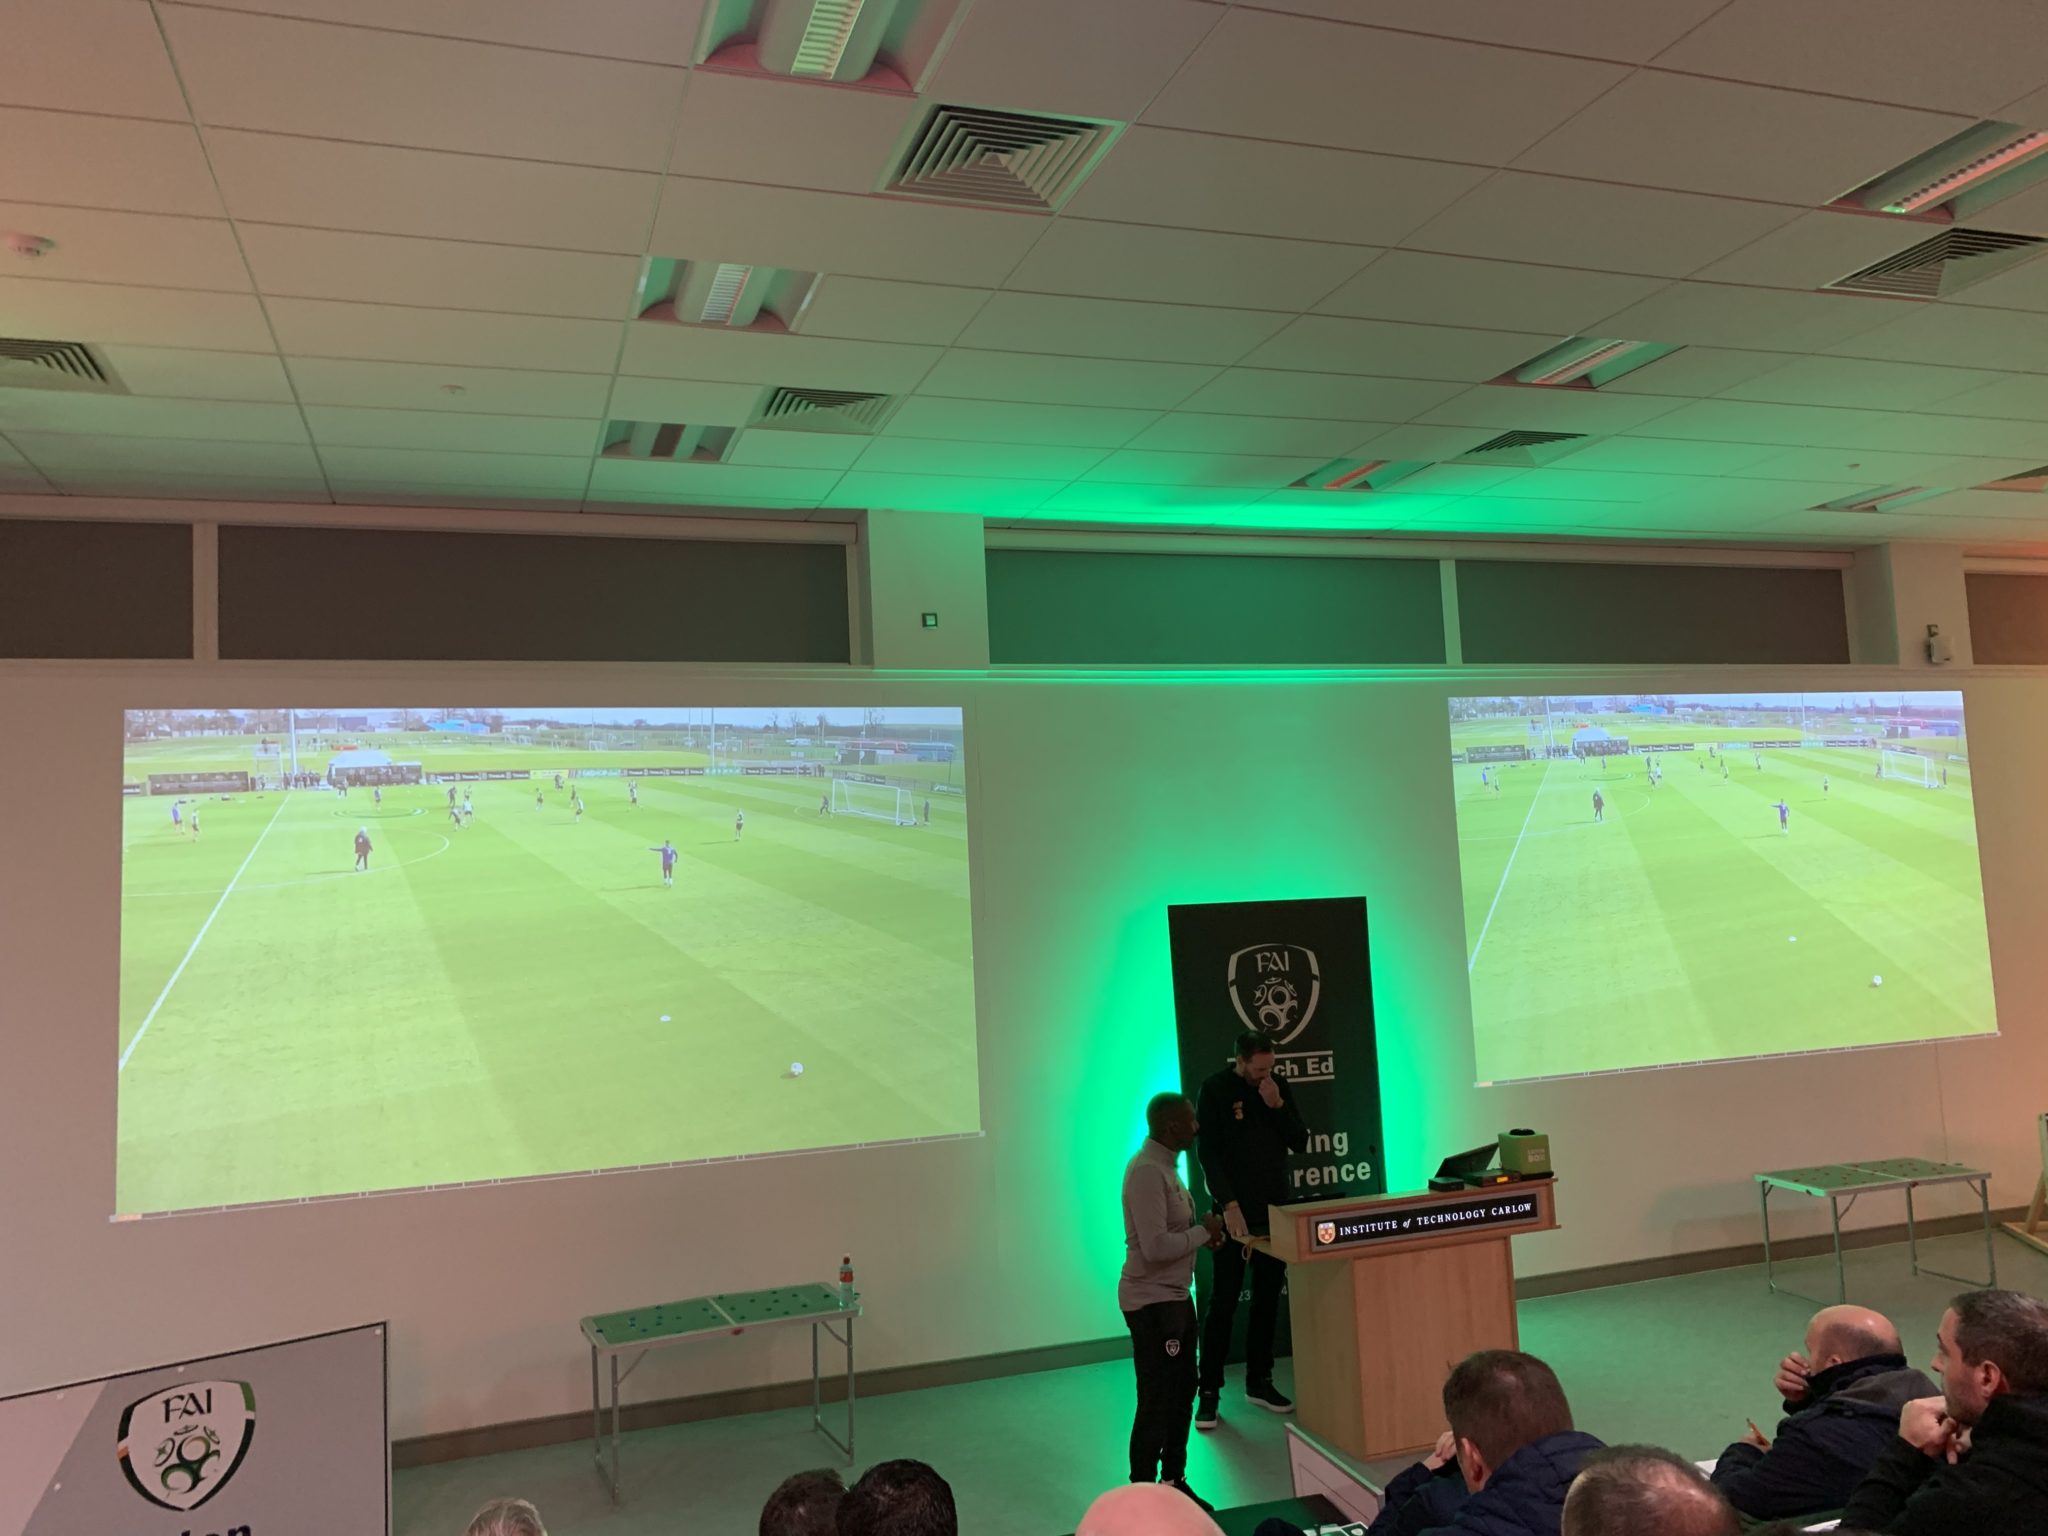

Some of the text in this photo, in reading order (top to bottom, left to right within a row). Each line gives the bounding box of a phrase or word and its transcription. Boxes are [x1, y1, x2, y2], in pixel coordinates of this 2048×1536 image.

[1256, 951, 1289, 973] FAI
[1274, 1056, 1334, 1077] ch Ed
[1306, 1129, 1349, 1157] ing
[1293, 1161, 1371, 1188] rence
[1339, 1203, 1532, 1236] INSTITUTE of TECHNOLOGY CARLOW
[163, 1388, 212, 1423] FAI
